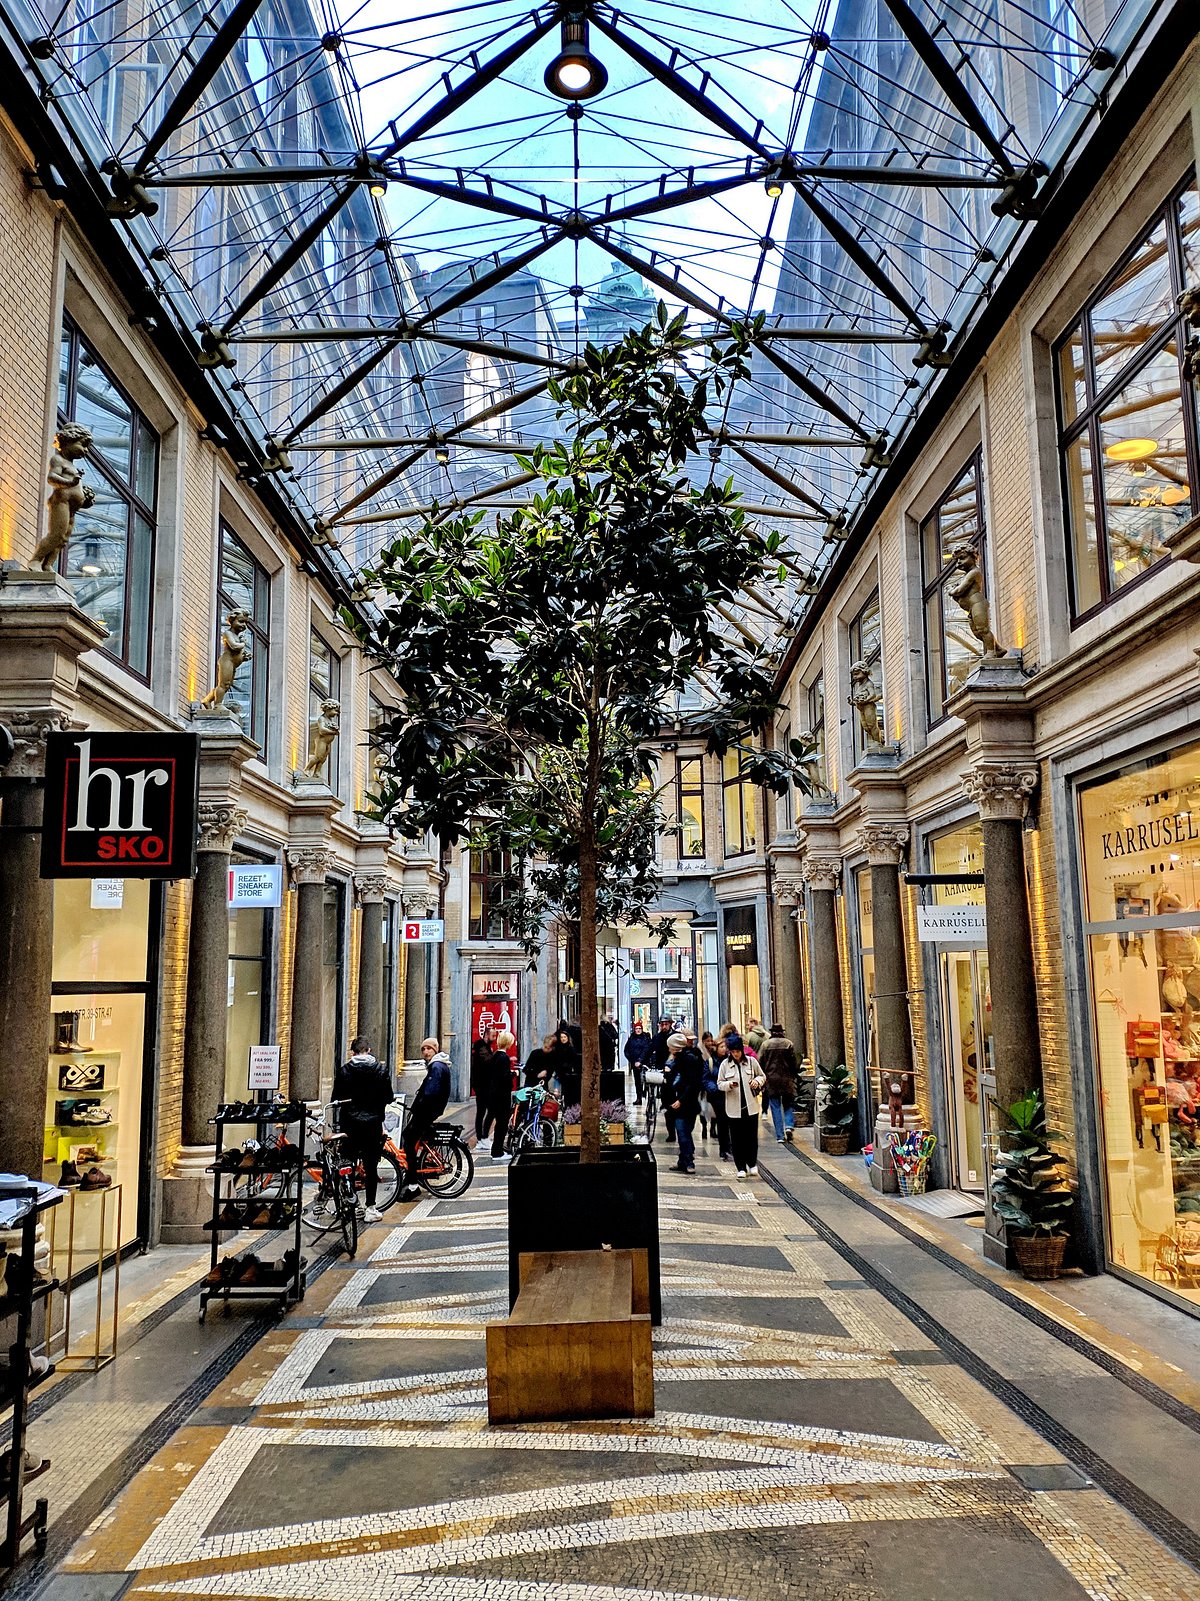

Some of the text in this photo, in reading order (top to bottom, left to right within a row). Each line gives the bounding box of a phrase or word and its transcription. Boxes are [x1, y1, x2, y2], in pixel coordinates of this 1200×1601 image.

[67, 738, 169, 832] hr
[1102, 811, 1199, 860] KARRUSEL
[97, 836, 164, 859] SKO
[237, 882, 274, 890] SNEAKER
[237, 889, 263, 897] STORE
[481, 980, 510, 993] JACK'S
